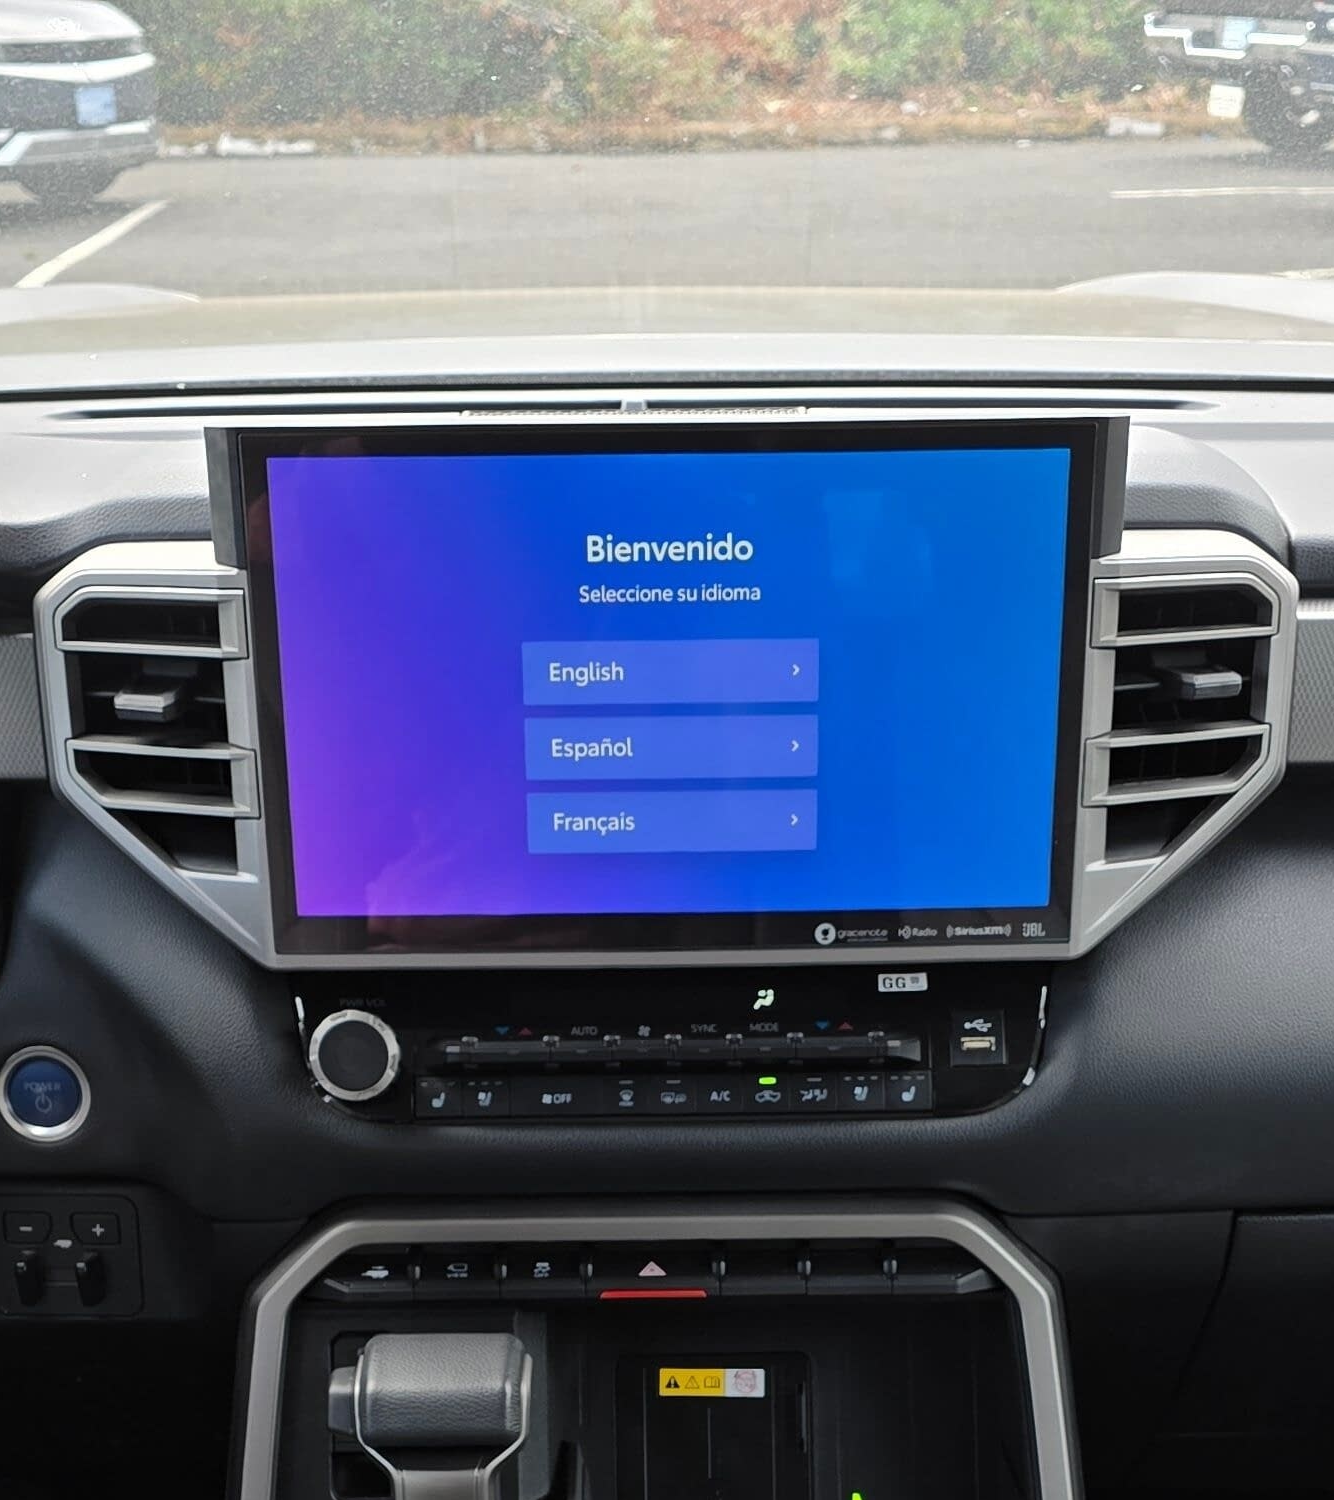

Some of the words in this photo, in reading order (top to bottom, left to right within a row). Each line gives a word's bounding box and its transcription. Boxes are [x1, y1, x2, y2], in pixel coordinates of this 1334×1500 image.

[586, 532, 754, 563] Bienvenido
[579, 585, 673, 603] Seleccione
[677, 586, 698, 602] su
[701, 583, 762, 602] idioma
[548, 661, 624, 687] English
[551, 737, 633, 761] Español
[553, 811, 635, 836] Français
[1022, 922, 1046, 938] JBL
[882, 976, 906, 989] GG
[571, 1025, 598, 1037] AUTO
[691, 1023, 717, 1033] SYNC
[750, 1021, 779, 1032] MODE
[554, 1093, 572, 1104] OFF
[710, 1090, 731, 1102] A/C
